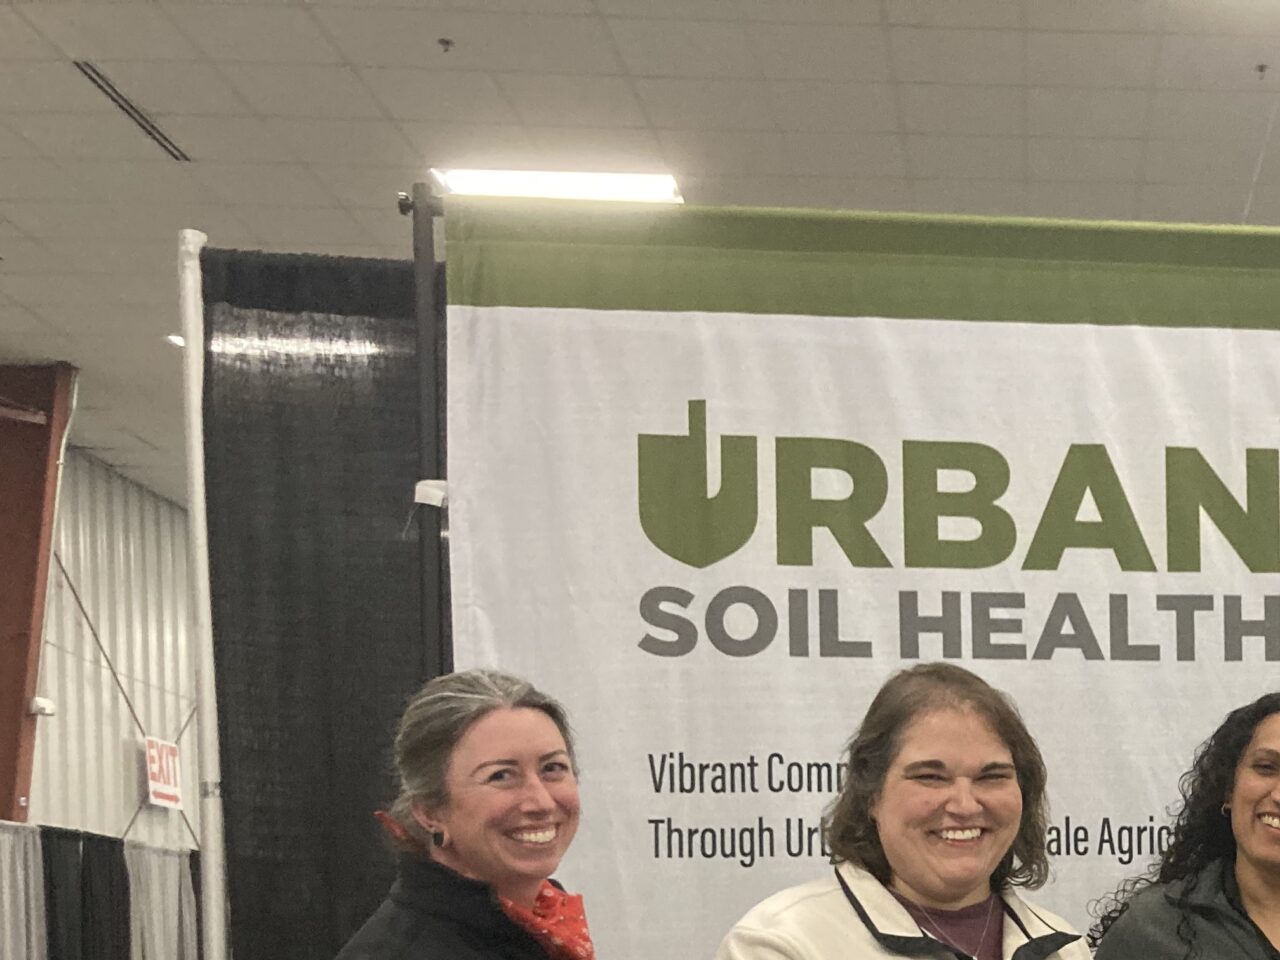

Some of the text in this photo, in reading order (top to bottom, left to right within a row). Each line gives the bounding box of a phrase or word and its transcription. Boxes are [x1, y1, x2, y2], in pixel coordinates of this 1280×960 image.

[638, 400, 1280, 573] URBAN
[638, 586, 872, 659] SOIL
[146, 739, 178, 788] EXIT
[649, 752, 848, 793] Vibrant Com
[649, 817, 774, 866] Through
[1046, 816, 1089, 856] ale
[1098, 815, 1171, 865] Agric
